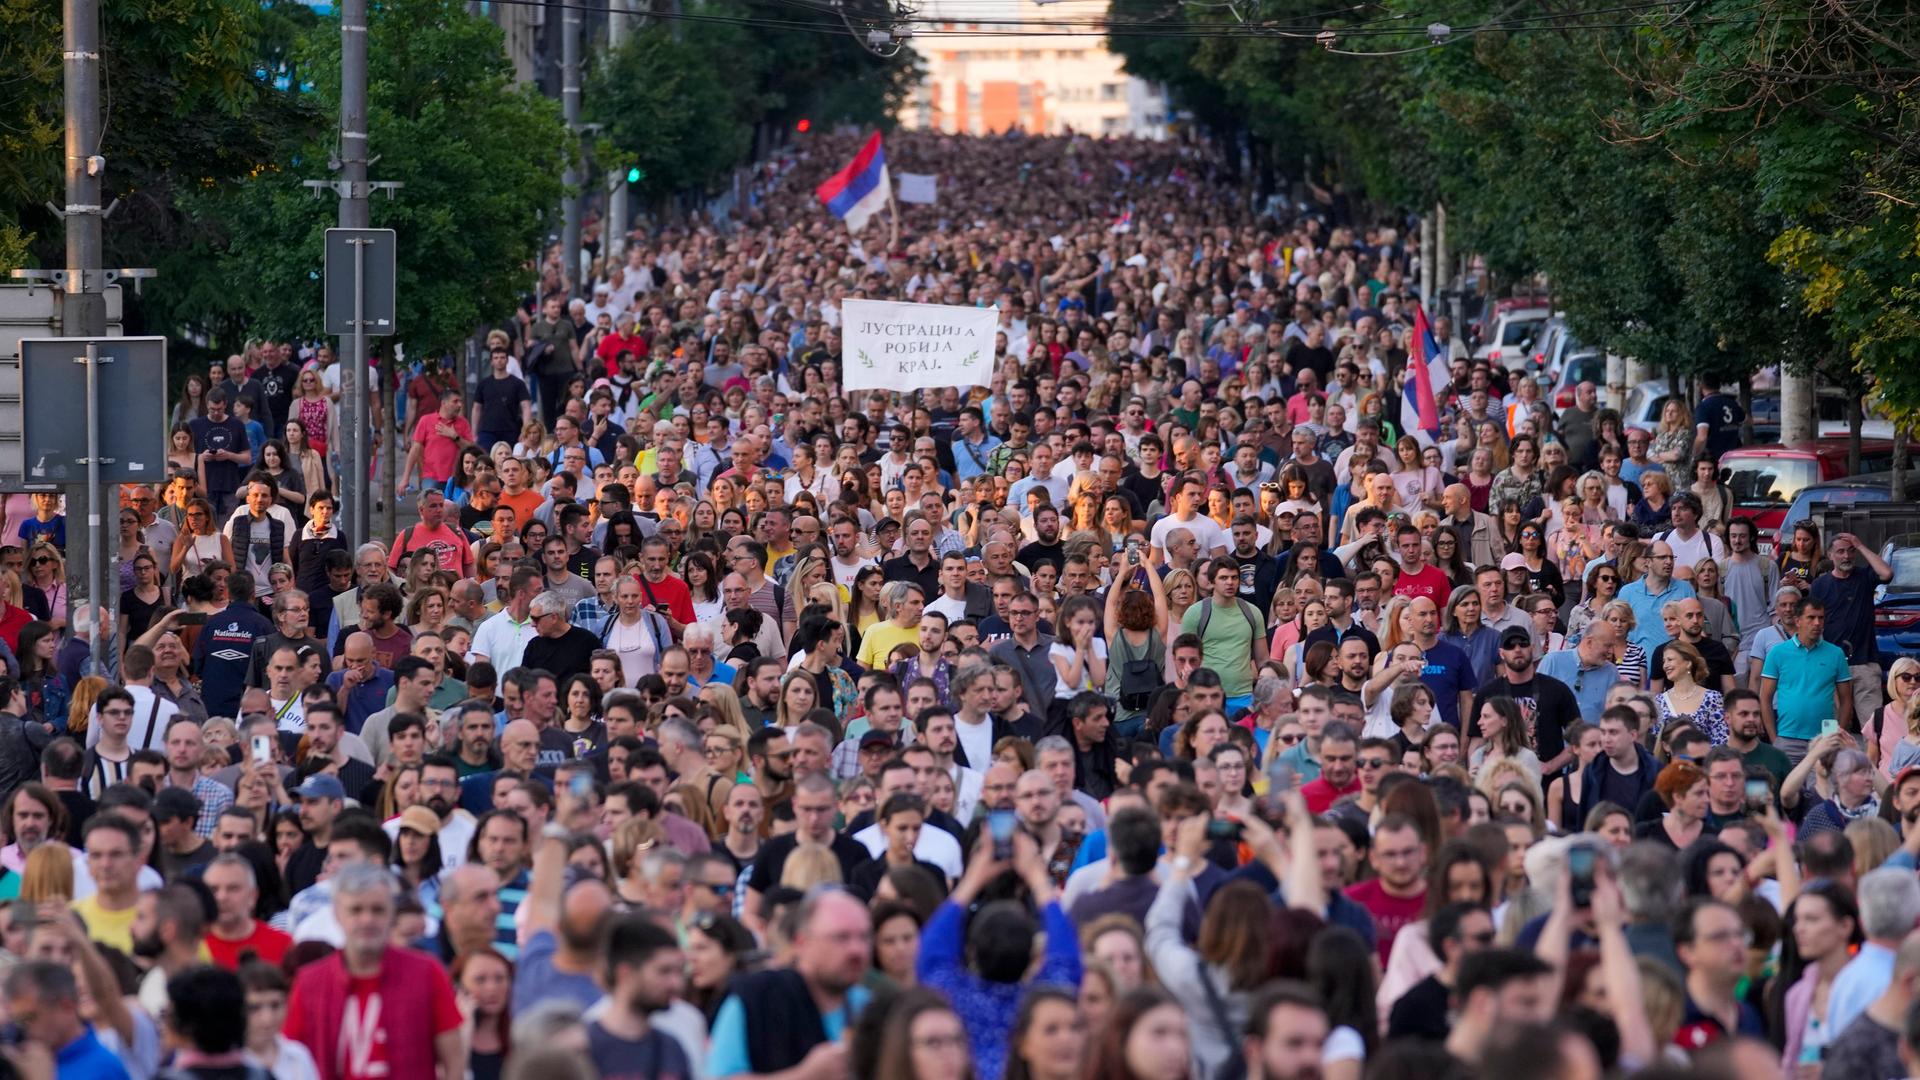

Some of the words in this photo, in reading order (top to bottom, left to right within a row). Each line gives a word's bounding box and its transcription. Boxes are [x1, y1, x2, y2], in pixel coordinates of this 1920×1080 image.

[860, 321, 975, 337] ЛУСТРАЦИЈА
[884, 341, 953, 354] РОБИЈА
[898, 358, 942, 374] КРАЈ.
[1722, 405, 1733, 424] 3
[213, 629, 253, 639] Nationwide
